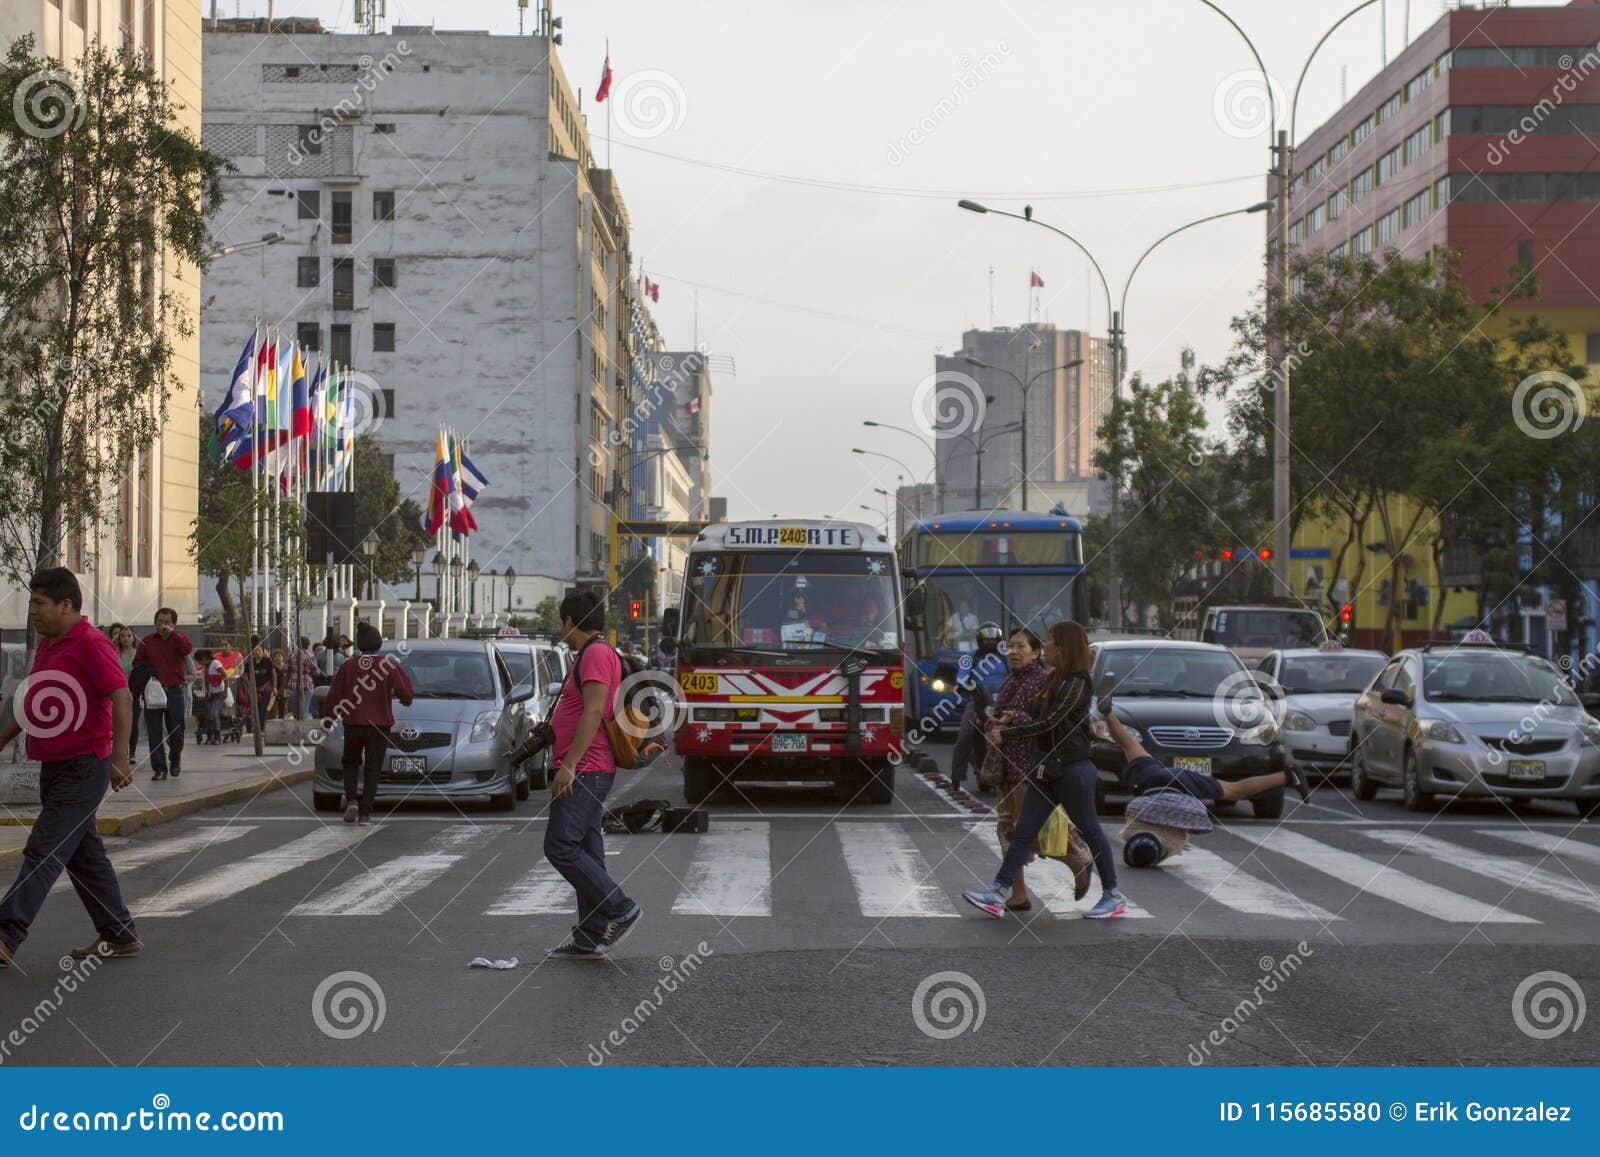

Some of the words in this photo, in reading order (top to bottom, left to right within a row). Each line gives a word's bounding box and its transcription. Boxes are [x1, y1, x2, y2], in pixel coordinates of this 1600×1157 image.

[780, 528, 807, 543] 2403
[807, 528, 851, 545] ATE
[682, 673, 715, 691] 2403
